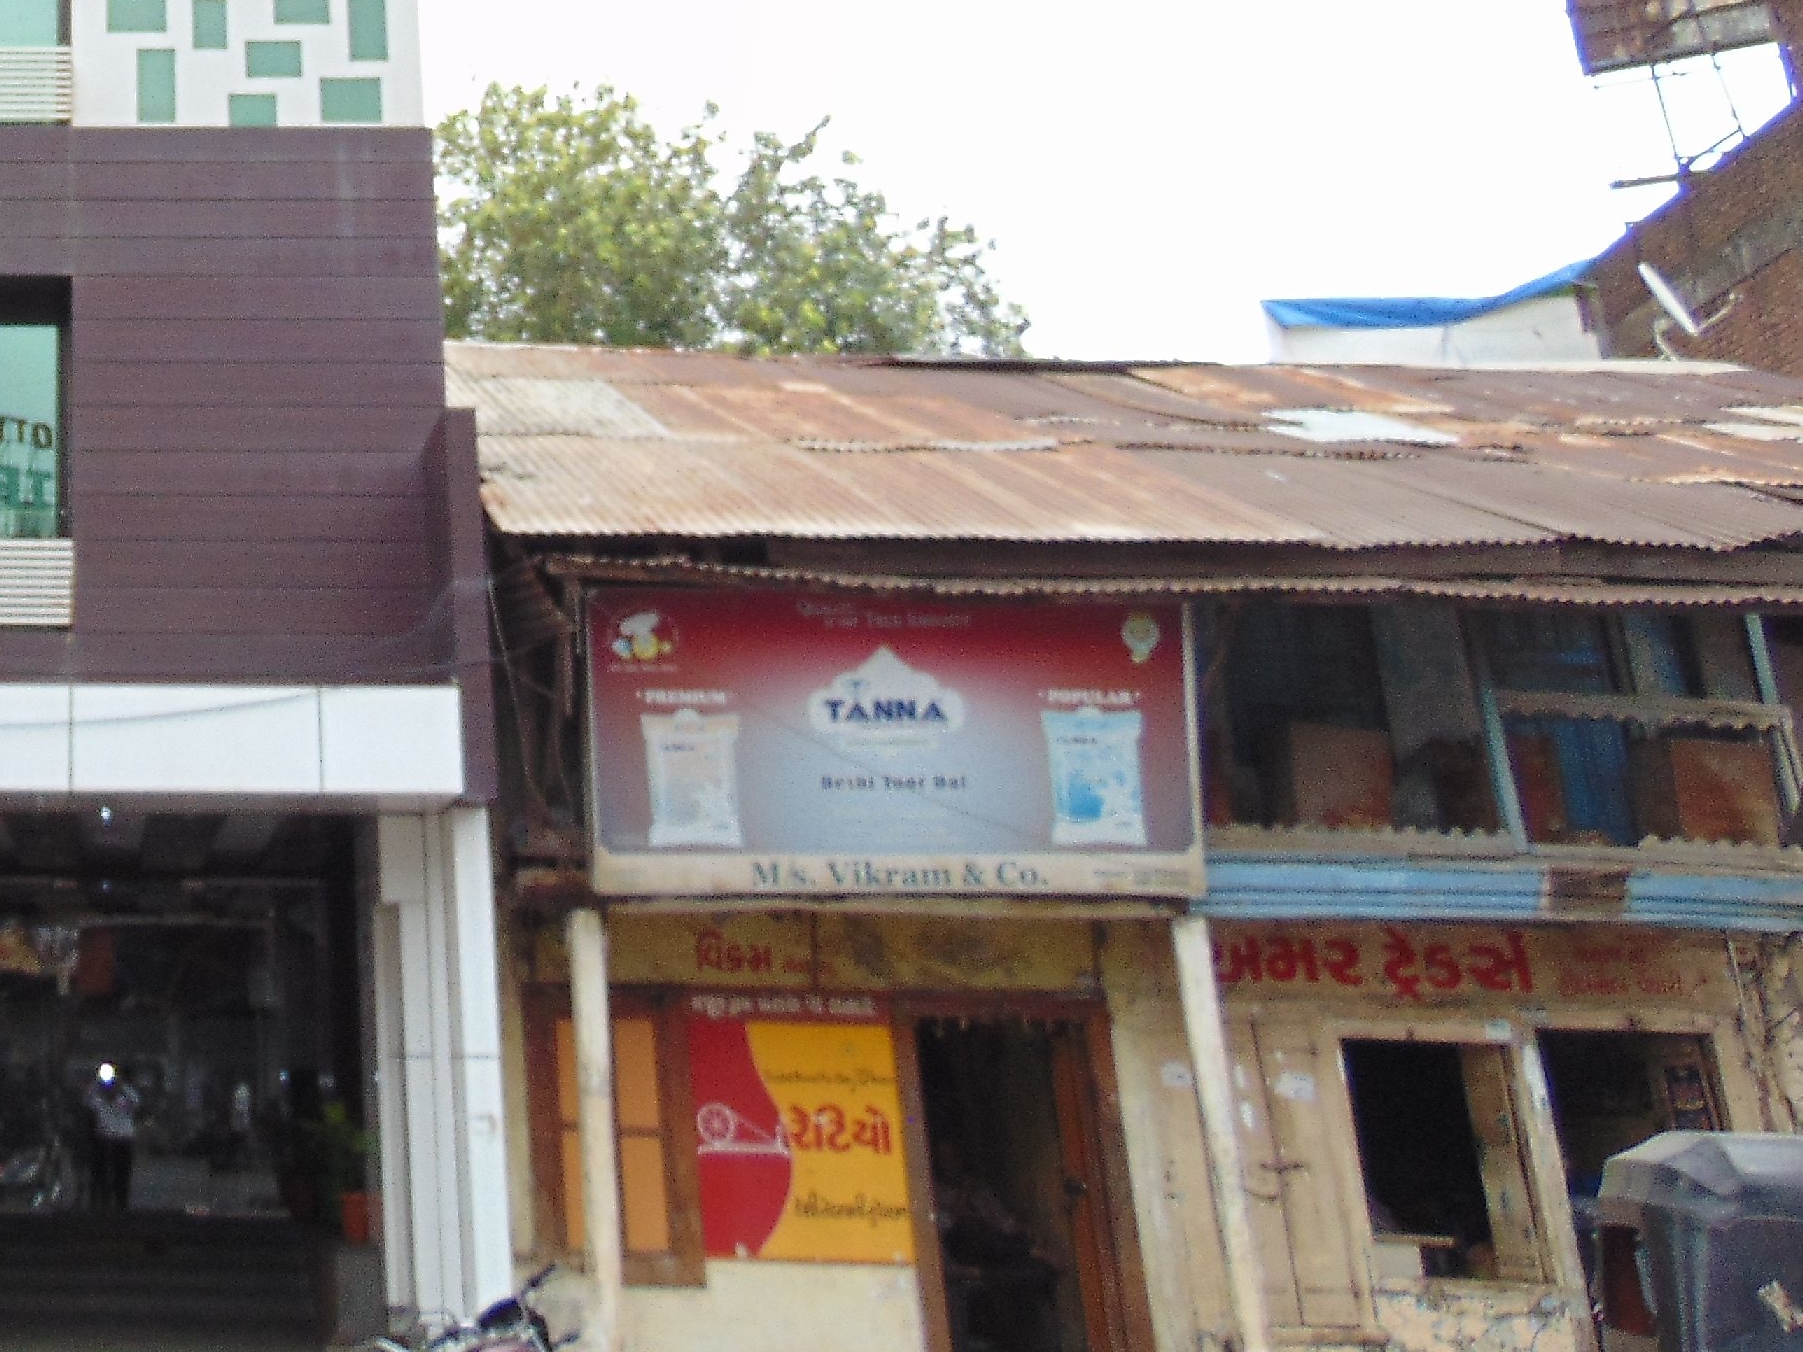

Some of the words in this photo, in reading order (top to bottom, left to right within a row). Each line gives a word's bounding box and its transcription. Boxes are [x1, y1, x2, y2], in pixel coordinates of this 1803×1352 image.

[825, 698, 948, 724] TANNA
[829, 860, 952, 887] Vikram
[963, 861, 985, 886] &
